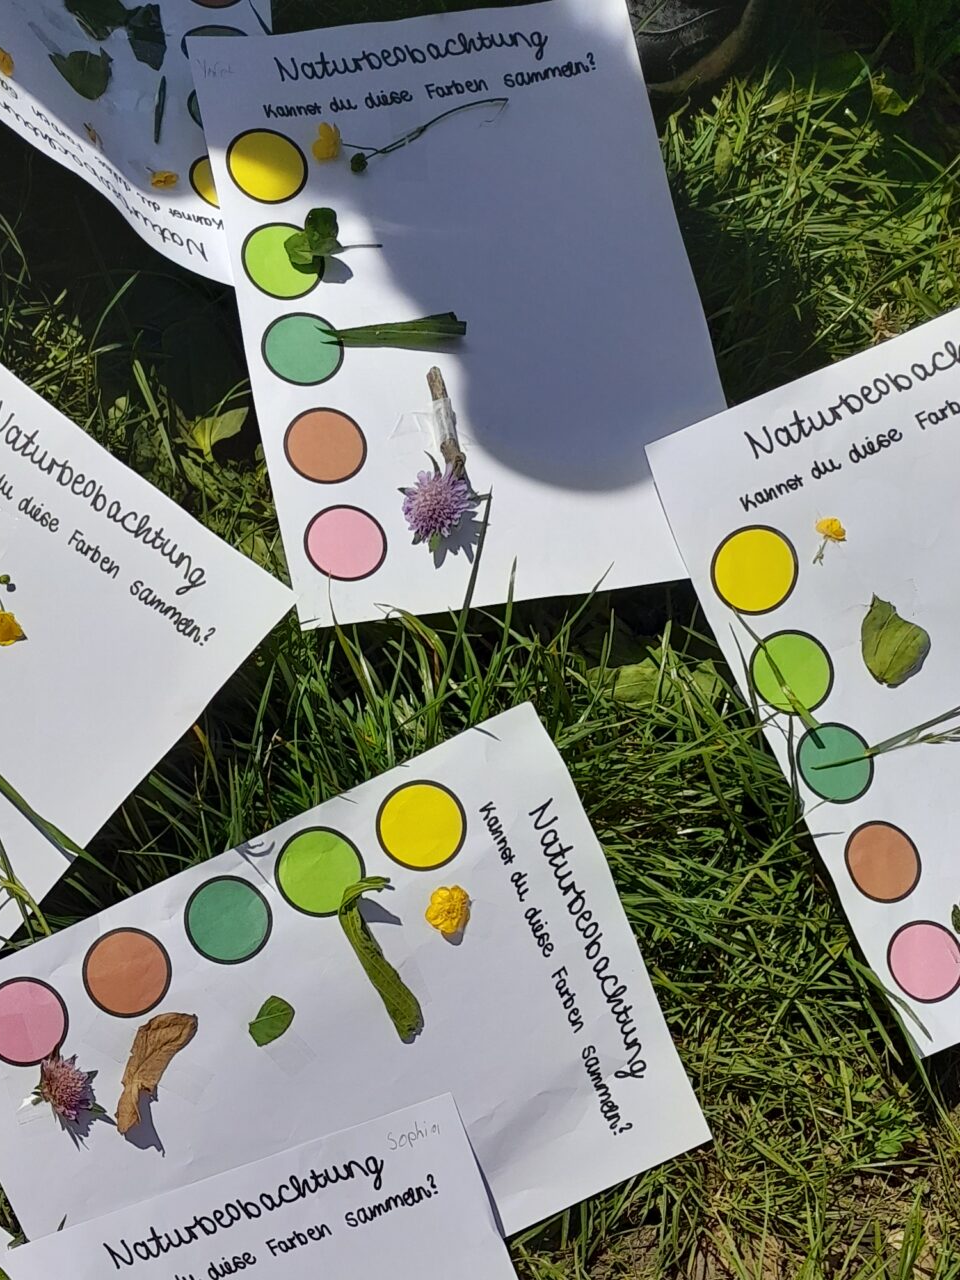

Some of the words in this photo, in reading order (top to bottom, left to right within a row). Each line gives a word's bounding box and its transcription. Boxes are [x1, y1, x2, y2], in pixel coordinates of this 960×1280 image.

[263, 102, 322, 119] Kannst
[329, 96, 357, 112] du
[364, 89, 413, 109] diese
[425, 79, 488, 100] Farben
[503, 52, 597, 88] sammeln?
[273, 29, 548, 82] Naturbeobachtung
[168, 207, 225, 230] Kannst
[739, 474, 803, 512] Kannst
[811, 458, 842, 479] du
[849, 428, 902, 463] diese
[18, 497, 59, 532] diese
[68, 529, 121, 579] Farben
[130, 579, 216, 646] sammeln?
[479, 801, 515, 866] Kannst
[511, 871, 533, 902] du
[524, 907, 555, 958] diese
[551, 965, 584, 1034] Farben
[581, 1045, 633, 1135] sammeln?
[528, 798, 647, 1079] Naturbeobachtung
[387, 1121, 441, 1150] Sophia
[103, 1155, 384, 1270] Naturbeobachtung
[265, 1222, 332, 1258] Farben
[344, 1173, 439, 1228] sammeln?
